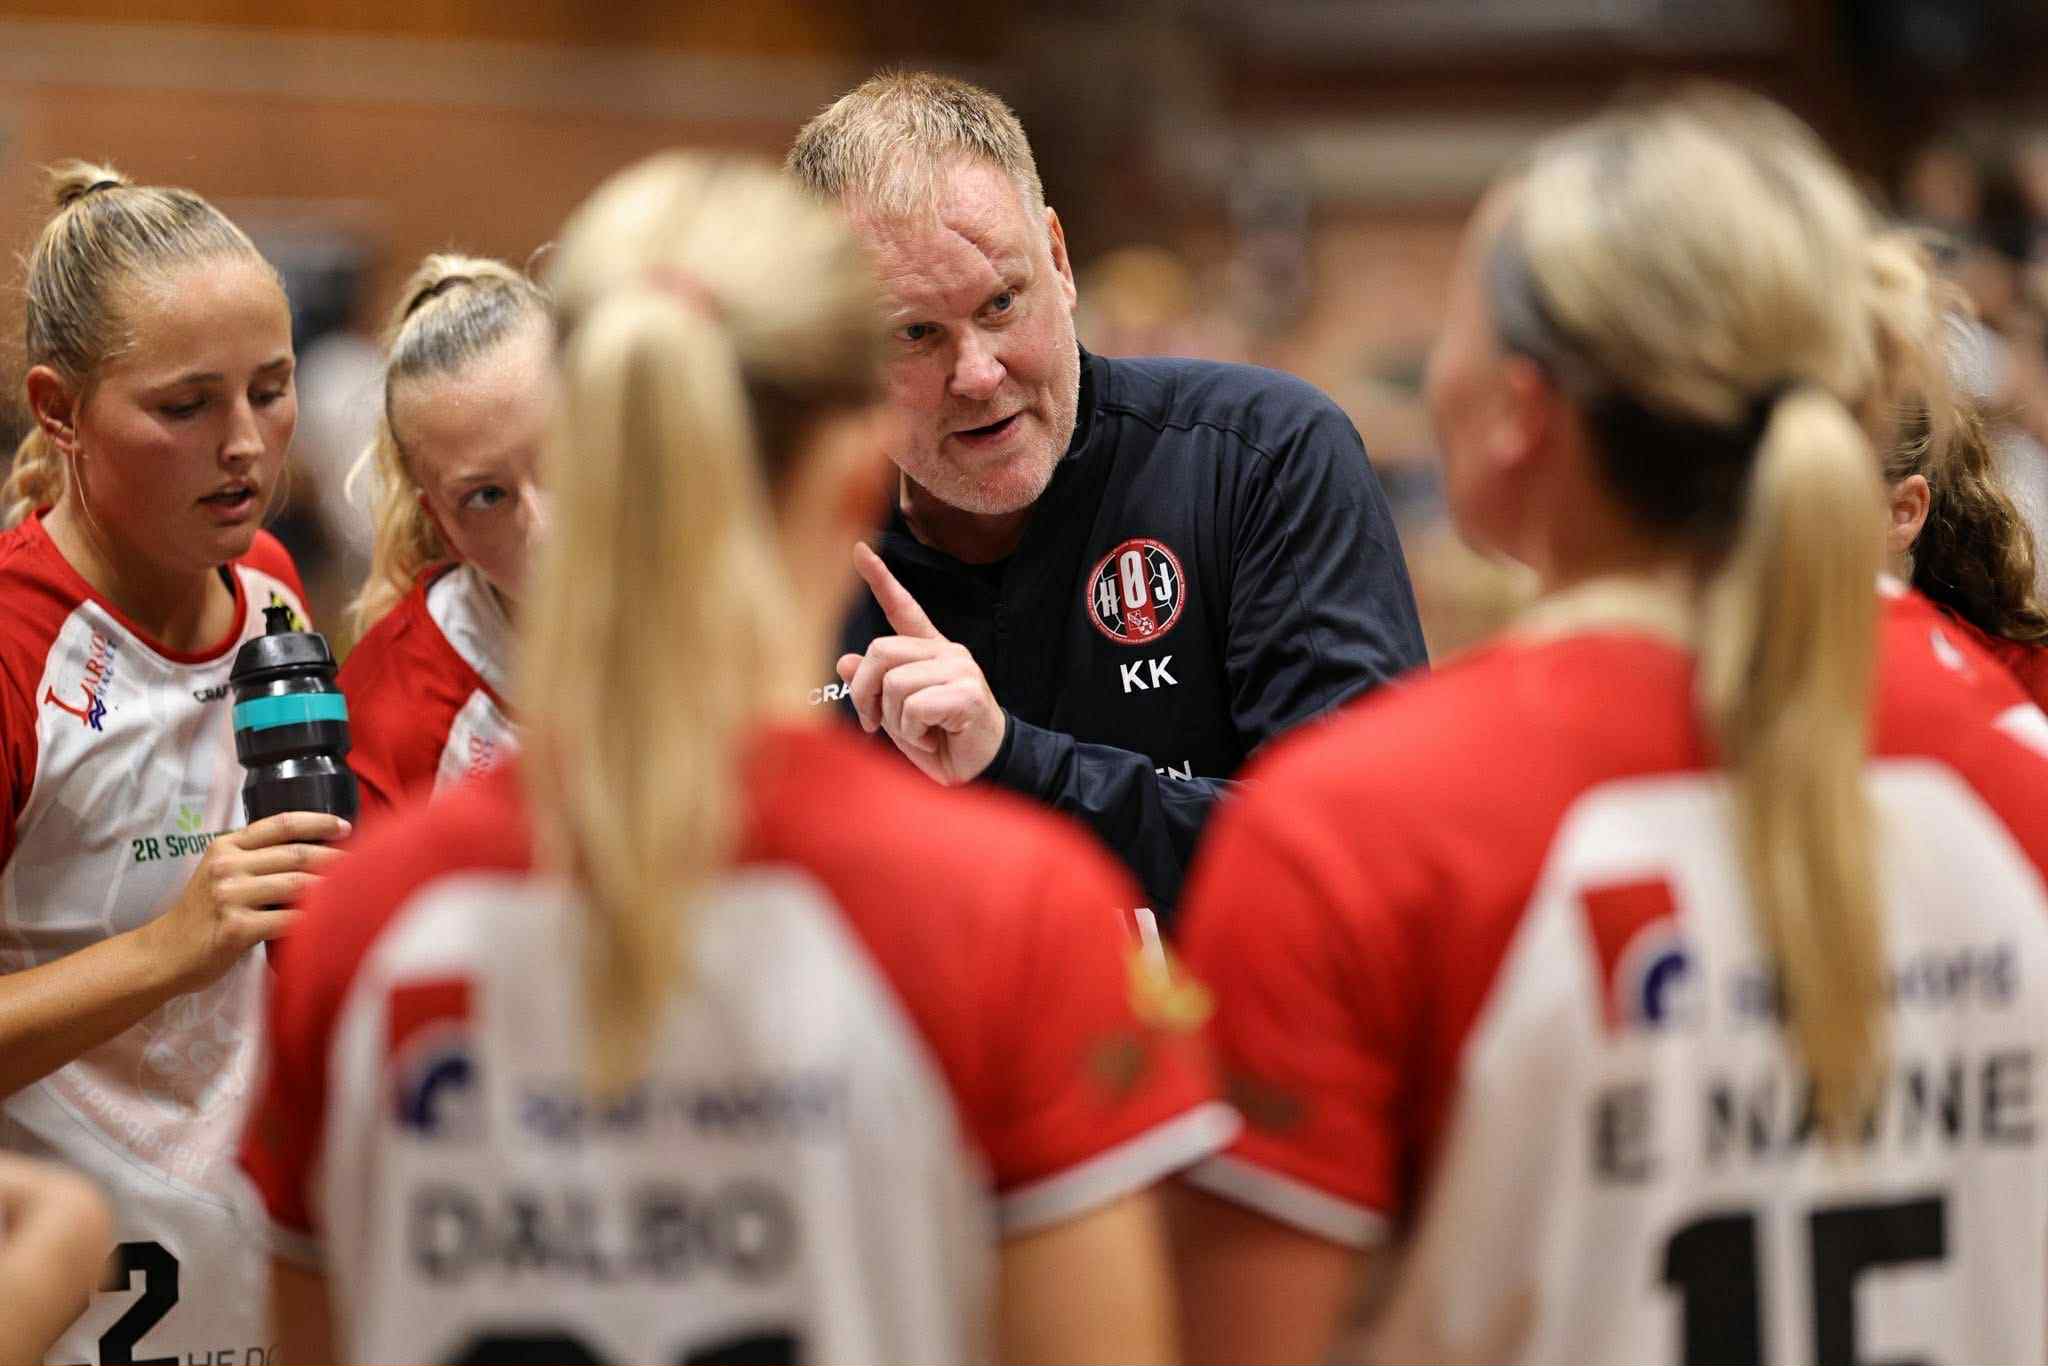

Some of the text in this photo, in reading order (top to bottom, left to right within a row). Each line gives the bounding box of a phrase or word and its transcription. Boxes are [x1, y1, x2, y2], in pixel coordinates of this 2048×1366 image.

[1119, 655, 1179, 694] KK
[132, 832, 217, 862] 2R SPORT
